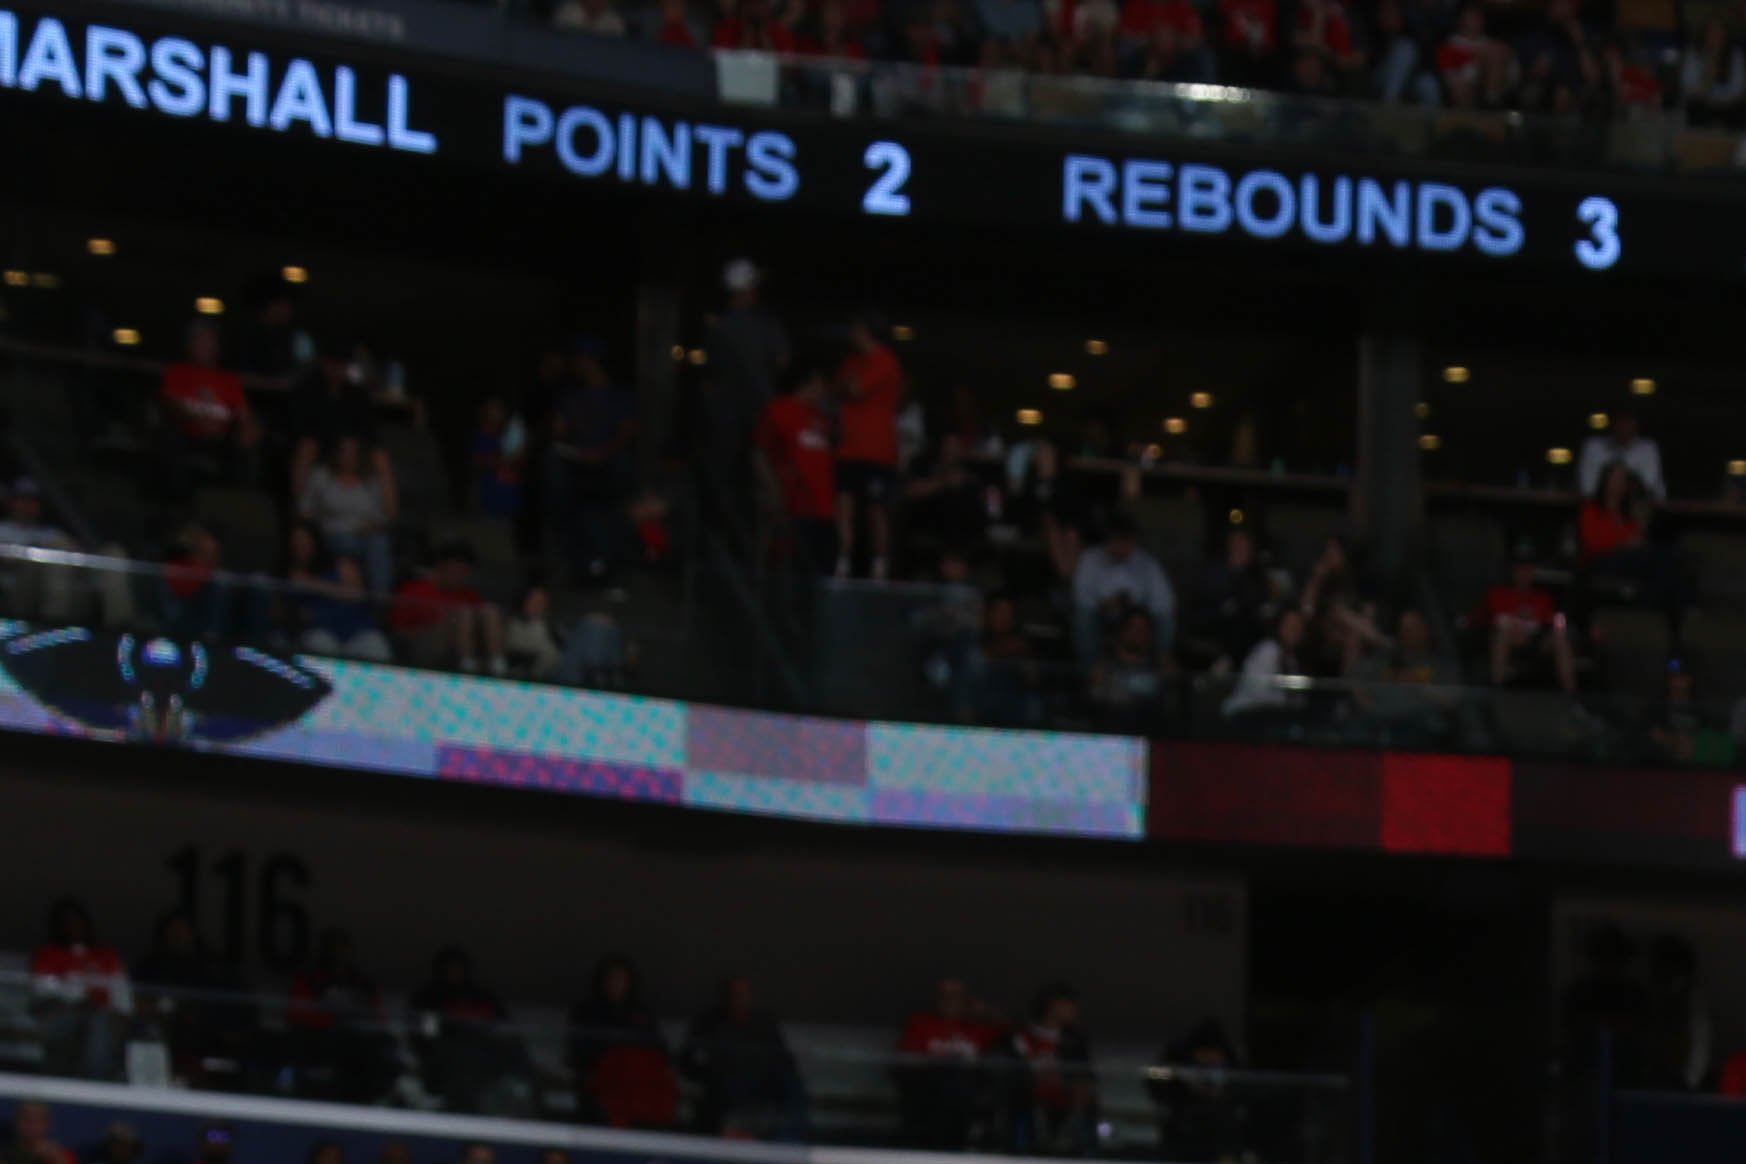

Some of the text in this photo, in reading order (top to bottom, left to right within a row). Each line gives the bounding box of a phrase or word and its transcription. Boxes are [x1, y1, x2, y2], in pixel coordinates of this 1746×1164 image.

[503, 93, 800, 202] POINTS
[863, 140, 912, 217] 2
[1062, 152, 1525, 258] REBOUNDS
[1575, 195, 1622, 272] 3
[165, 843, 313, 972] 116
